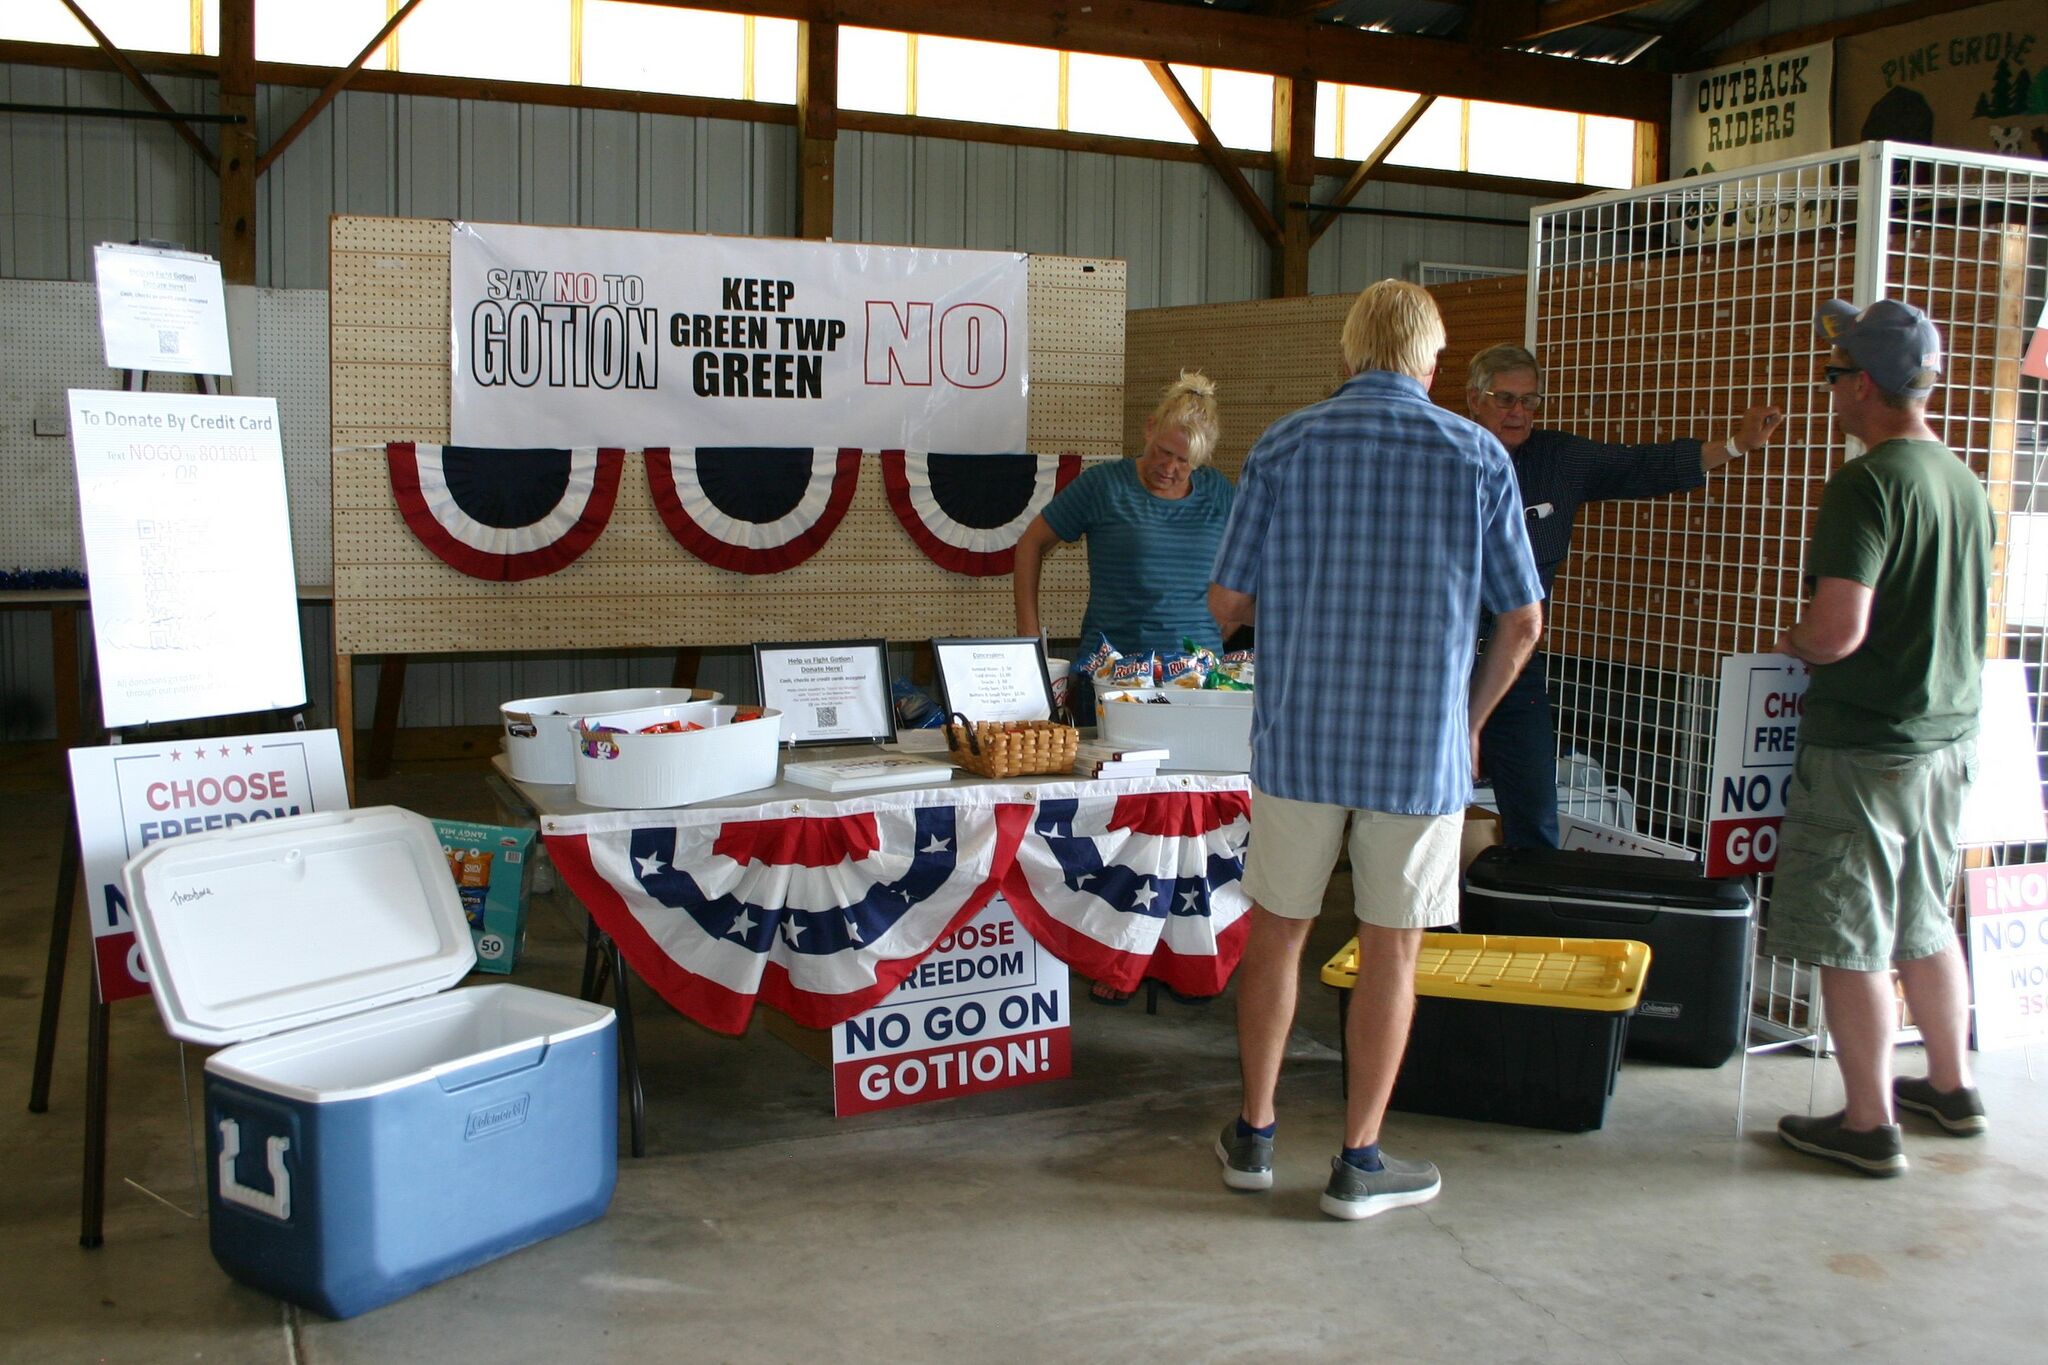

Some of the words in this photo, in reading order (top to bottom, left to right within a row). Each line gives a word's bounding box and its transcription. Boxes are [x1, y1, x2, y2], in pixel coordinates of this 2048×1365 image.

[1698, 56, 1809, 114] OUTBACK
[1708, 102, 1796, 152] RIDERS
[487, 268, 547, 302] SAY
[553, 272, 597, 304] NO
[603, 275, 644, 305] TO
[722, 277, 795, 313] KEEP
[472, 300, 658, 390] GOTION
[670, 312, 768, 350] GREEN
[776, 316, 846, 352] TWP
[864, 300, 1007, 389] NO
[692, 350, 822, 399] GREEN
[80, 409, 99, 426] To
[105, 411, 162, 428] Donate
[168, 413, 185, 432] By
[191, 413, 236, 430] Credit
[240, 415, 273, 431] Card
[107, 451, 126, 461] Text
[129, 444, 182, 462] NOGO
[199, 446, 257, 462] 801801
[175, 465, 199, 481] OR
[801, 666, 824, 674] Donate
[146, 770, 288, 811] CHOOSE
[1721, 774, 1771, 813] NO
[481, 939, 501, 952] 50
[935, 921, 1014, 953] OOSE
[900, 951, 1023, 991] REEDOM
[845, 1012, 910, 1055] NO
[923, 1001, 986, 1041] GO
[999, 990, 1058, 1029] ON
[859, 1037, 1049, 1101] GOTION!
